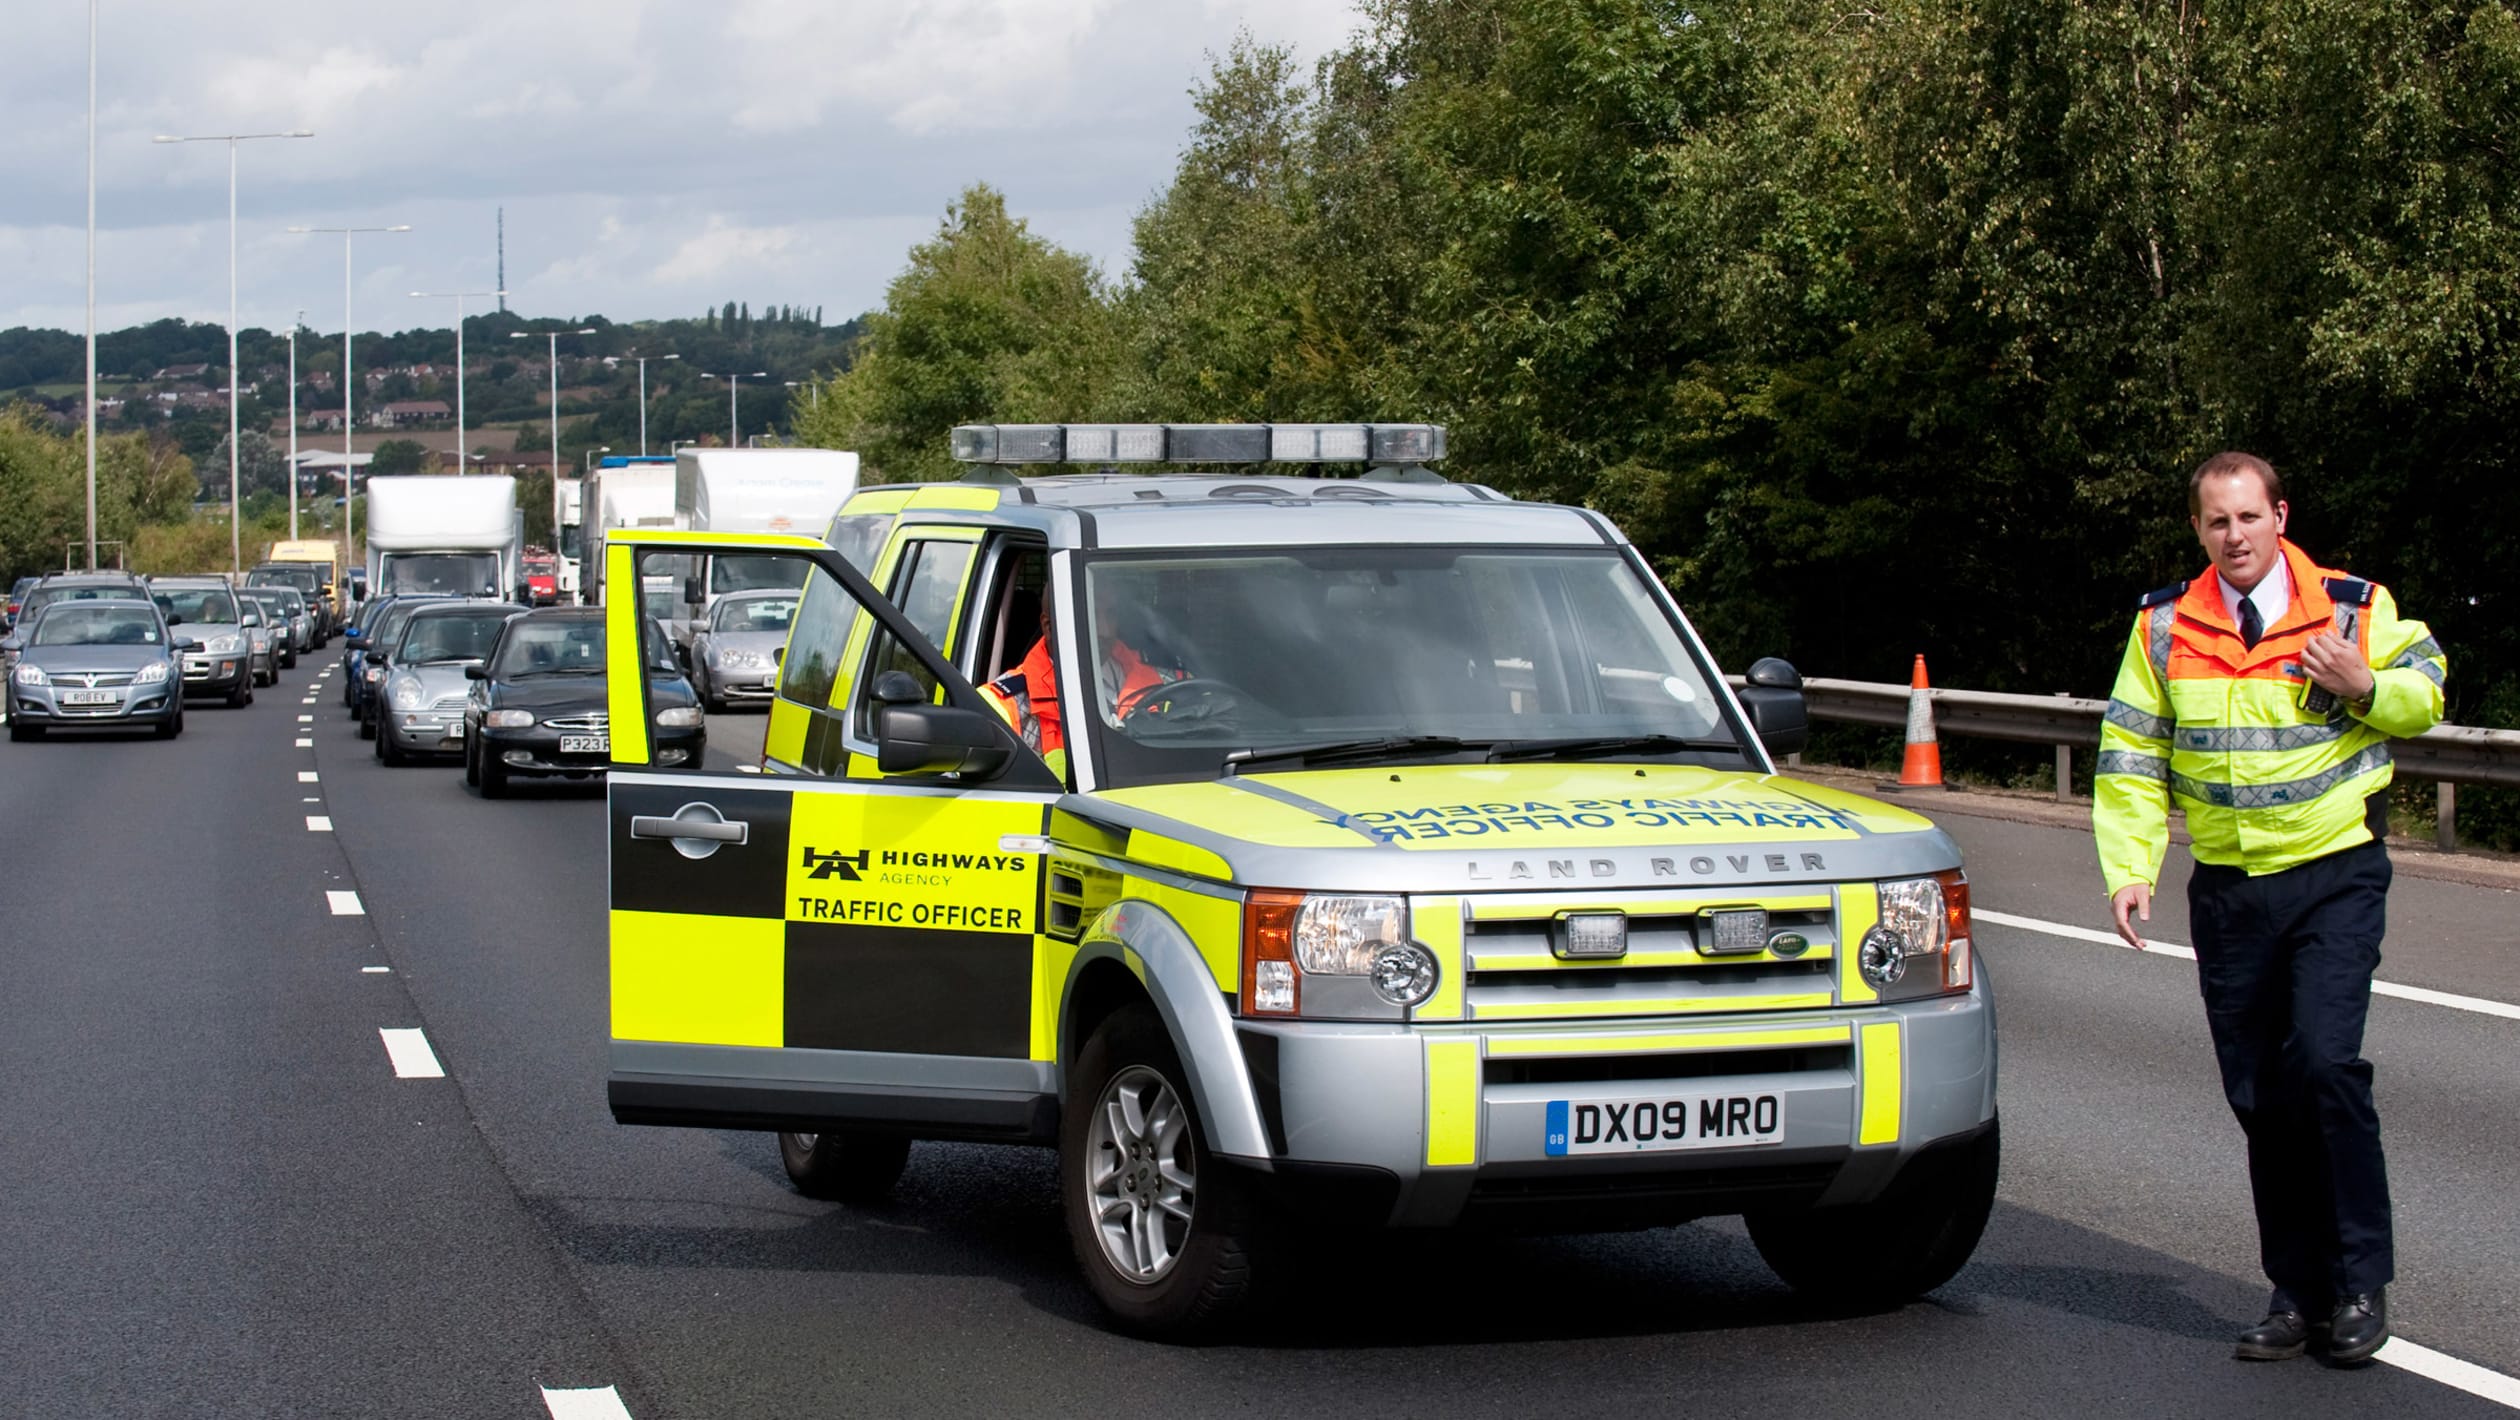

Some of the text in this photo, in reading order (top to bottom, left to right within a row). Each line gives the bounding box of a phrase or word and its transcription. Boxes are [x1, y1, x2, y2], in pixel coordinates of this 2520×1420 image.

[562, 738, 600, 750] P323
[881, 850, 1026, 871] HIGHWAYS
[1468, 852, 1827, 880] LAND ROVER
[879, 872, 953, 887] AGENCY
[798, 896, 1023, 929] TRAFFIC OFFICER
[1574, 1095, 1778, 1144] DX09 MRO
[1549, 1133, 1565, 1146] GB
